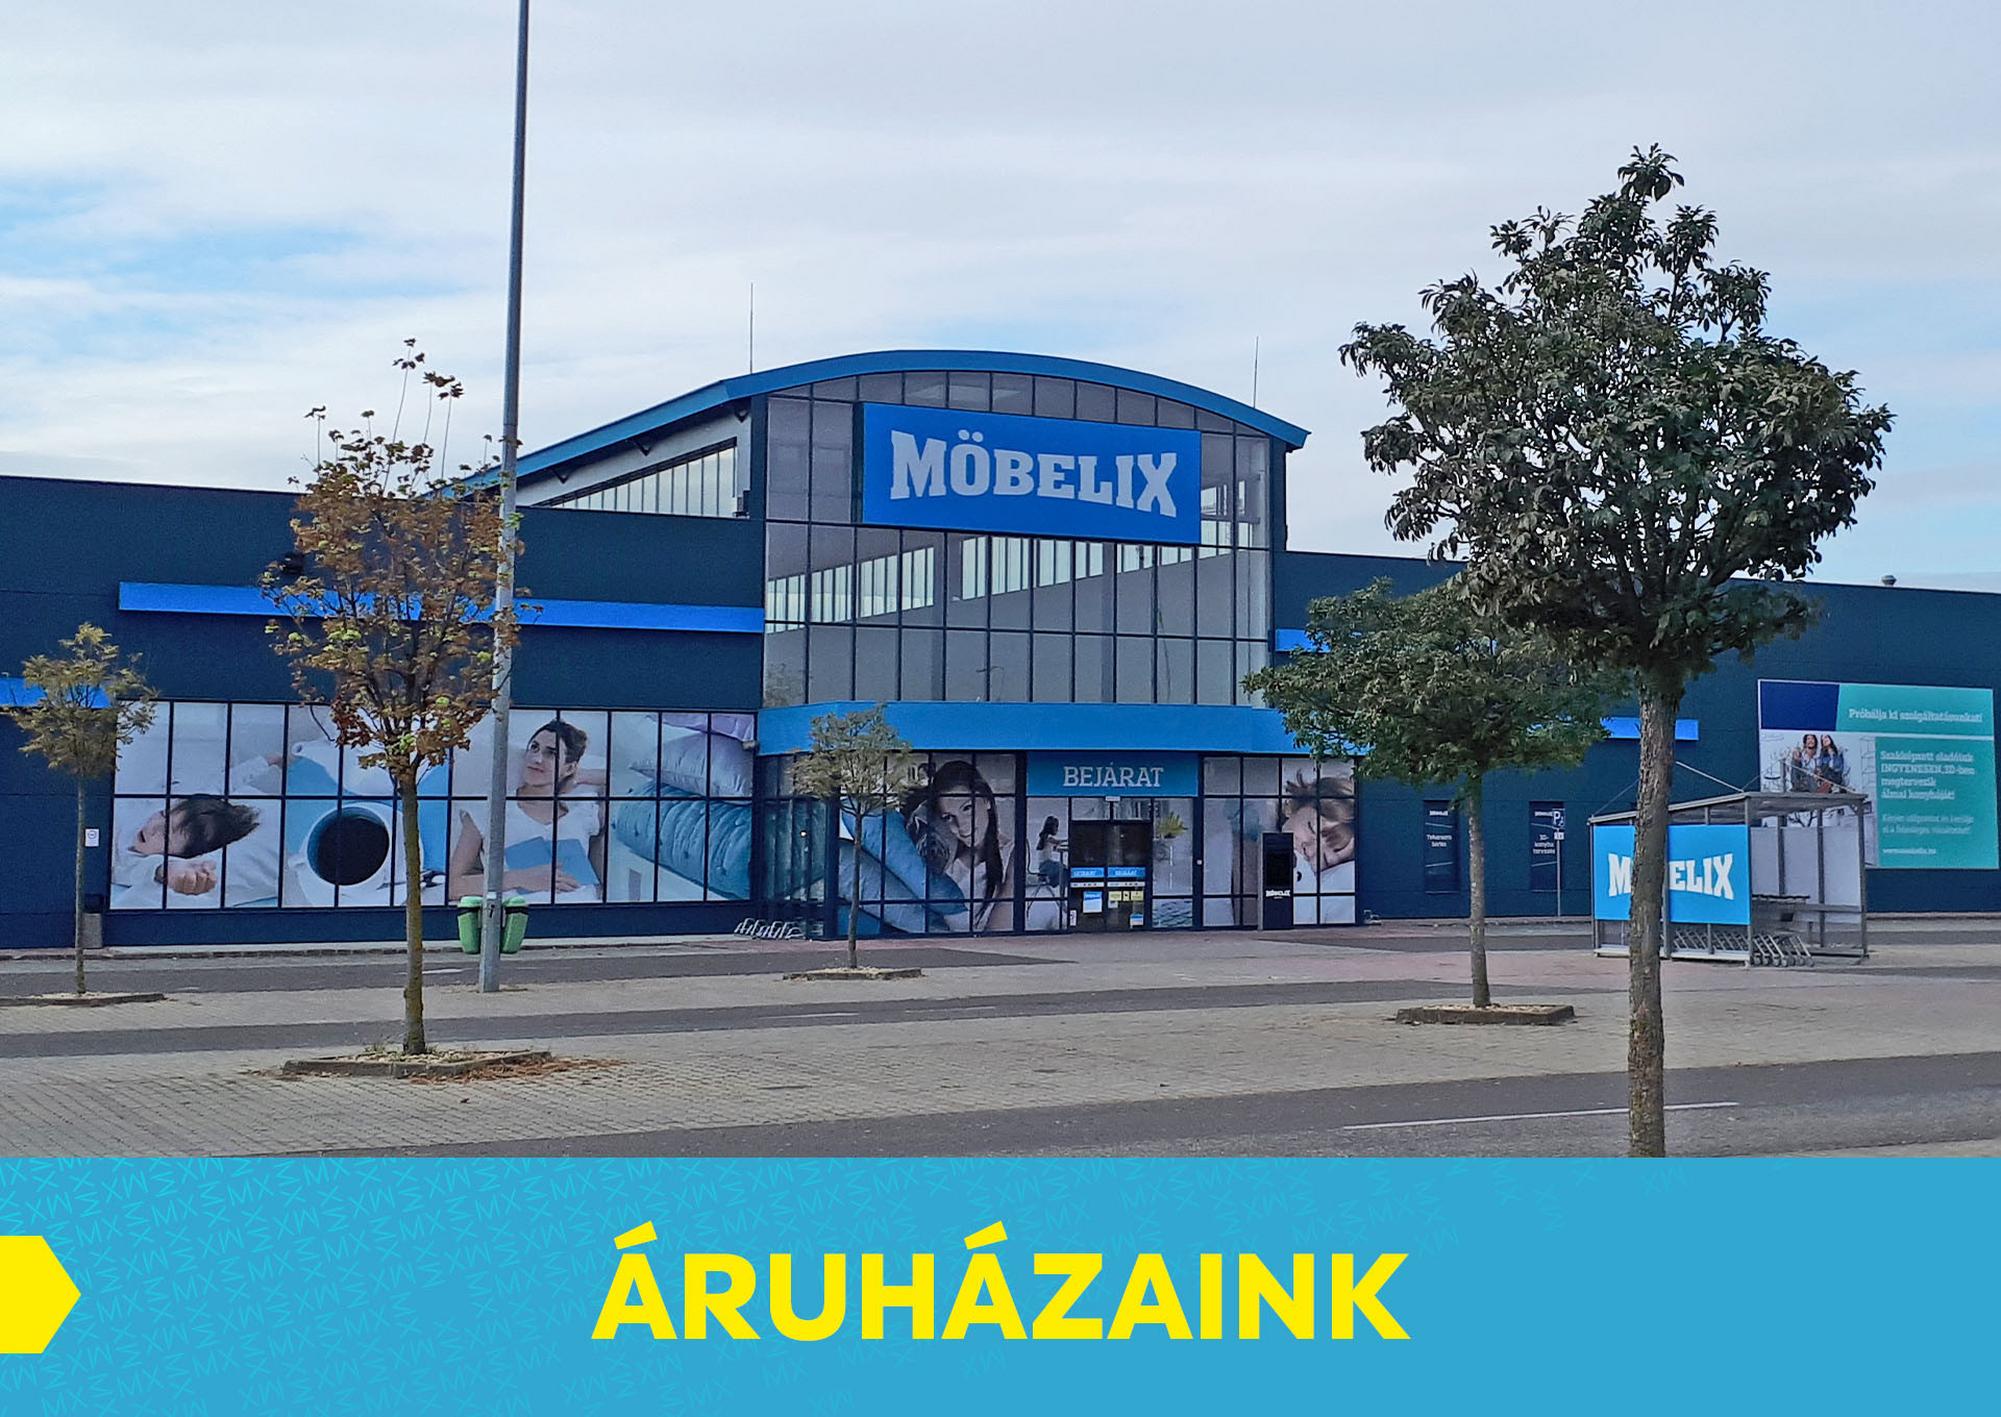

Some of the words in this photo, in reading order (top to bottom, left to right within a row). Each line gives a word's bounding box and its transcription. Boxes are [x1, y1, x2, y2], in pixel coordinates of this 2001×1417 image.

[889, 428, 1178, 518] MÖBELIX
[1062, 761, 1165, 789] BEJÁRAT
[1553, 811, 1561, 825] P
[1607, 852, 1735, 900] MELIX
